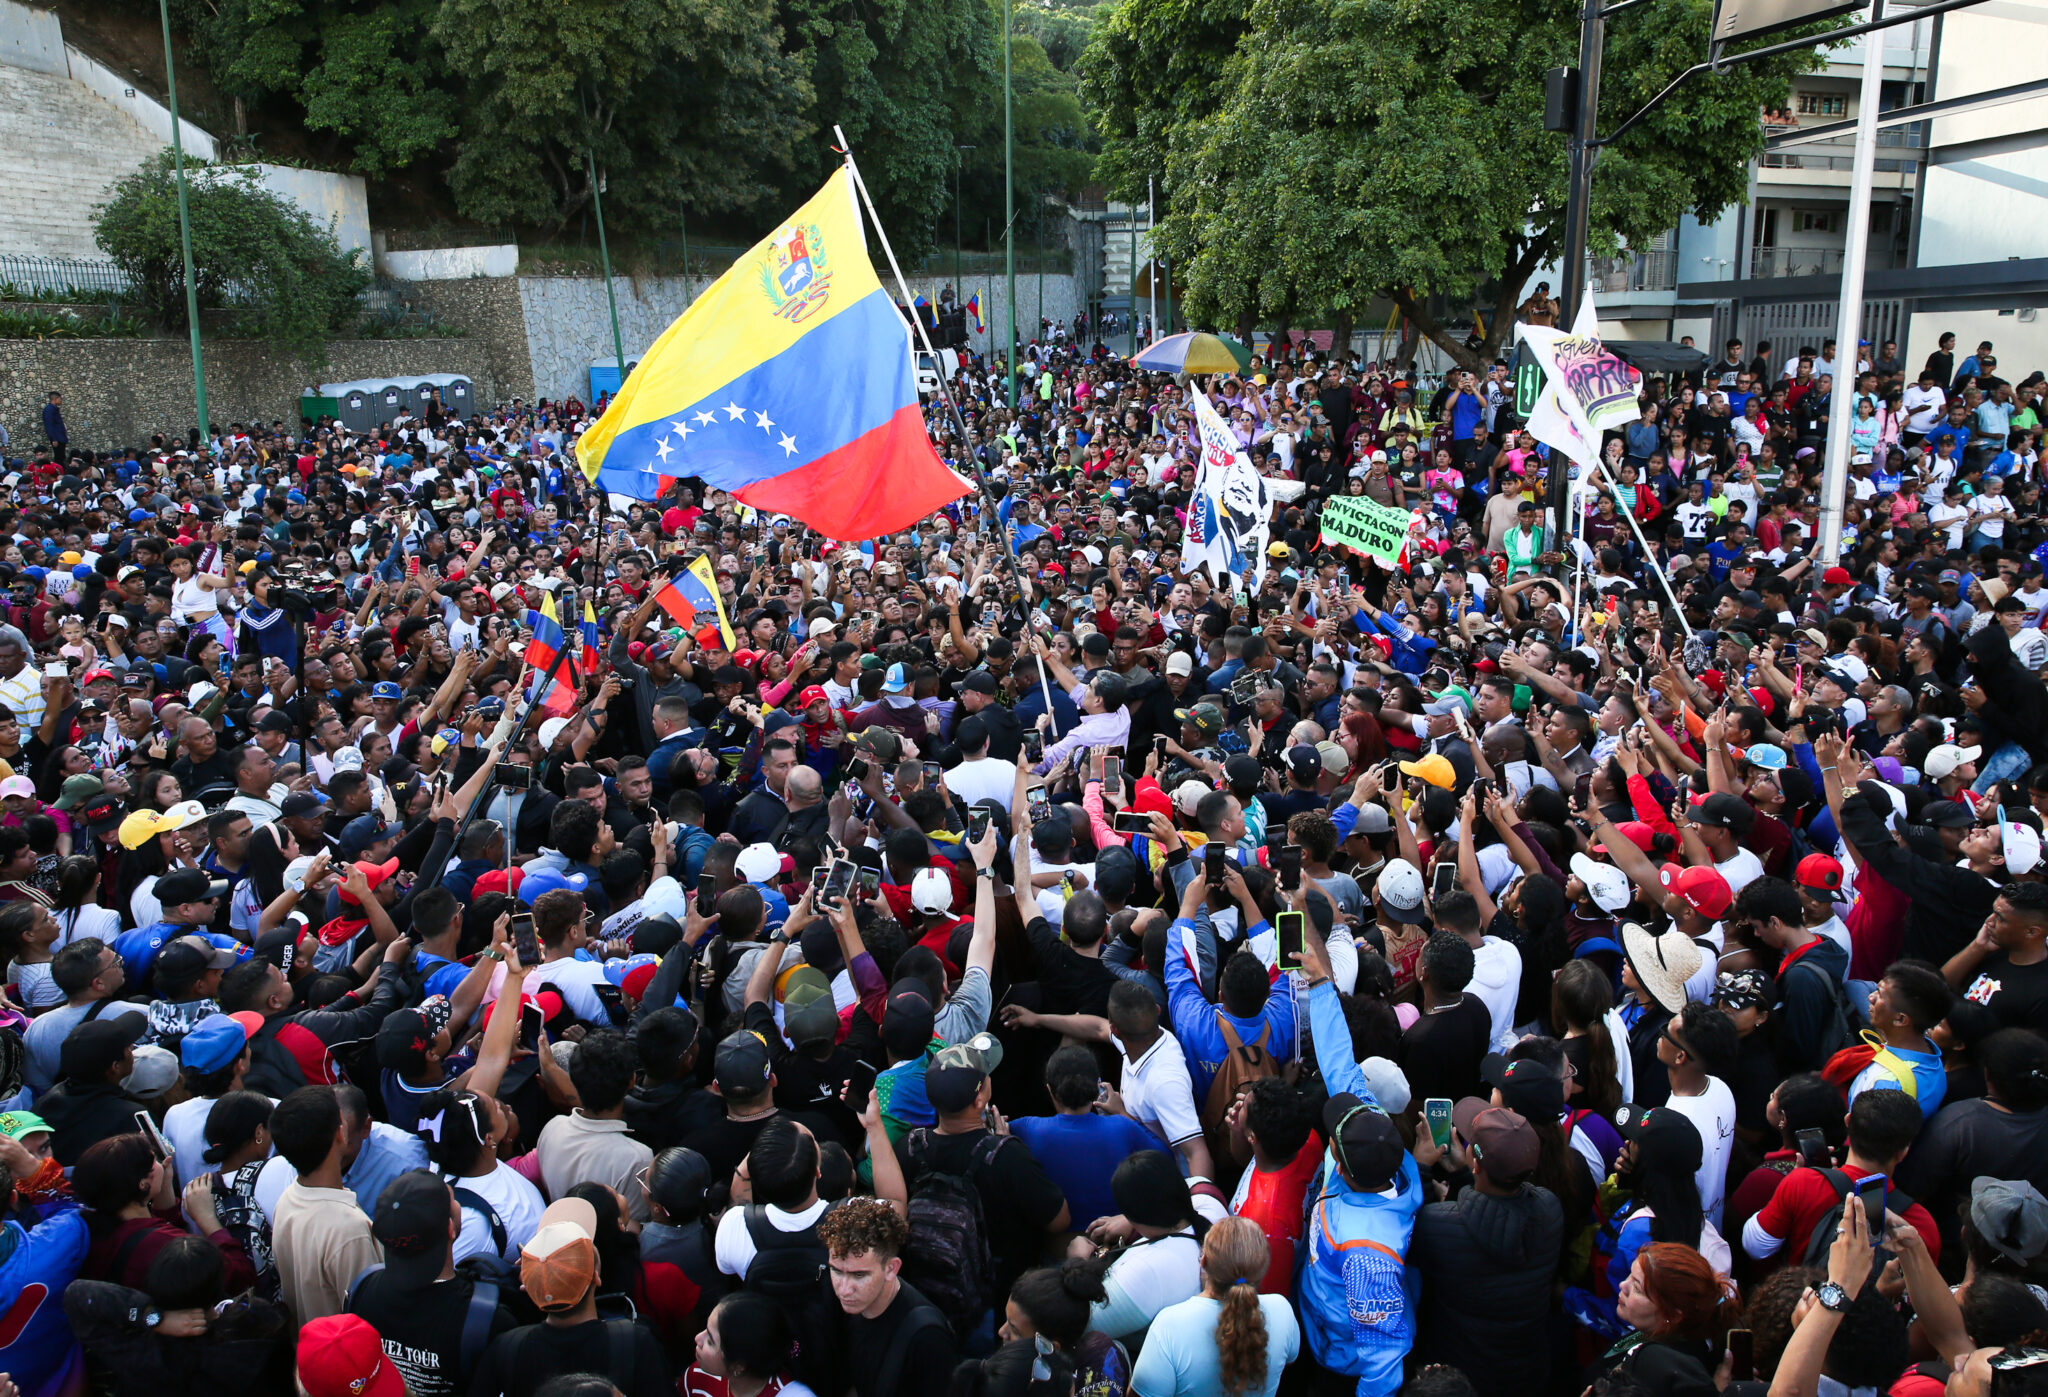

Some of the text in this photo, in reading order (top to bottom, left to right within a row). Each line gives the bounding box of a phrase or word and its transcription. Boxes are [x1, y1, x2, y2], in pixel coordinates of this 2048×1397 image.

[1689, 512, 1708, 532] 73
[1322, 514, 1393, 552] MADURO
[187, 805, 201, 816] C
[1430, 1109, 1447, 1118] 4:34
[1351, 1310, 1387, 1321] ALCALDE
[405, 1346, 441, 1368] TOUR
